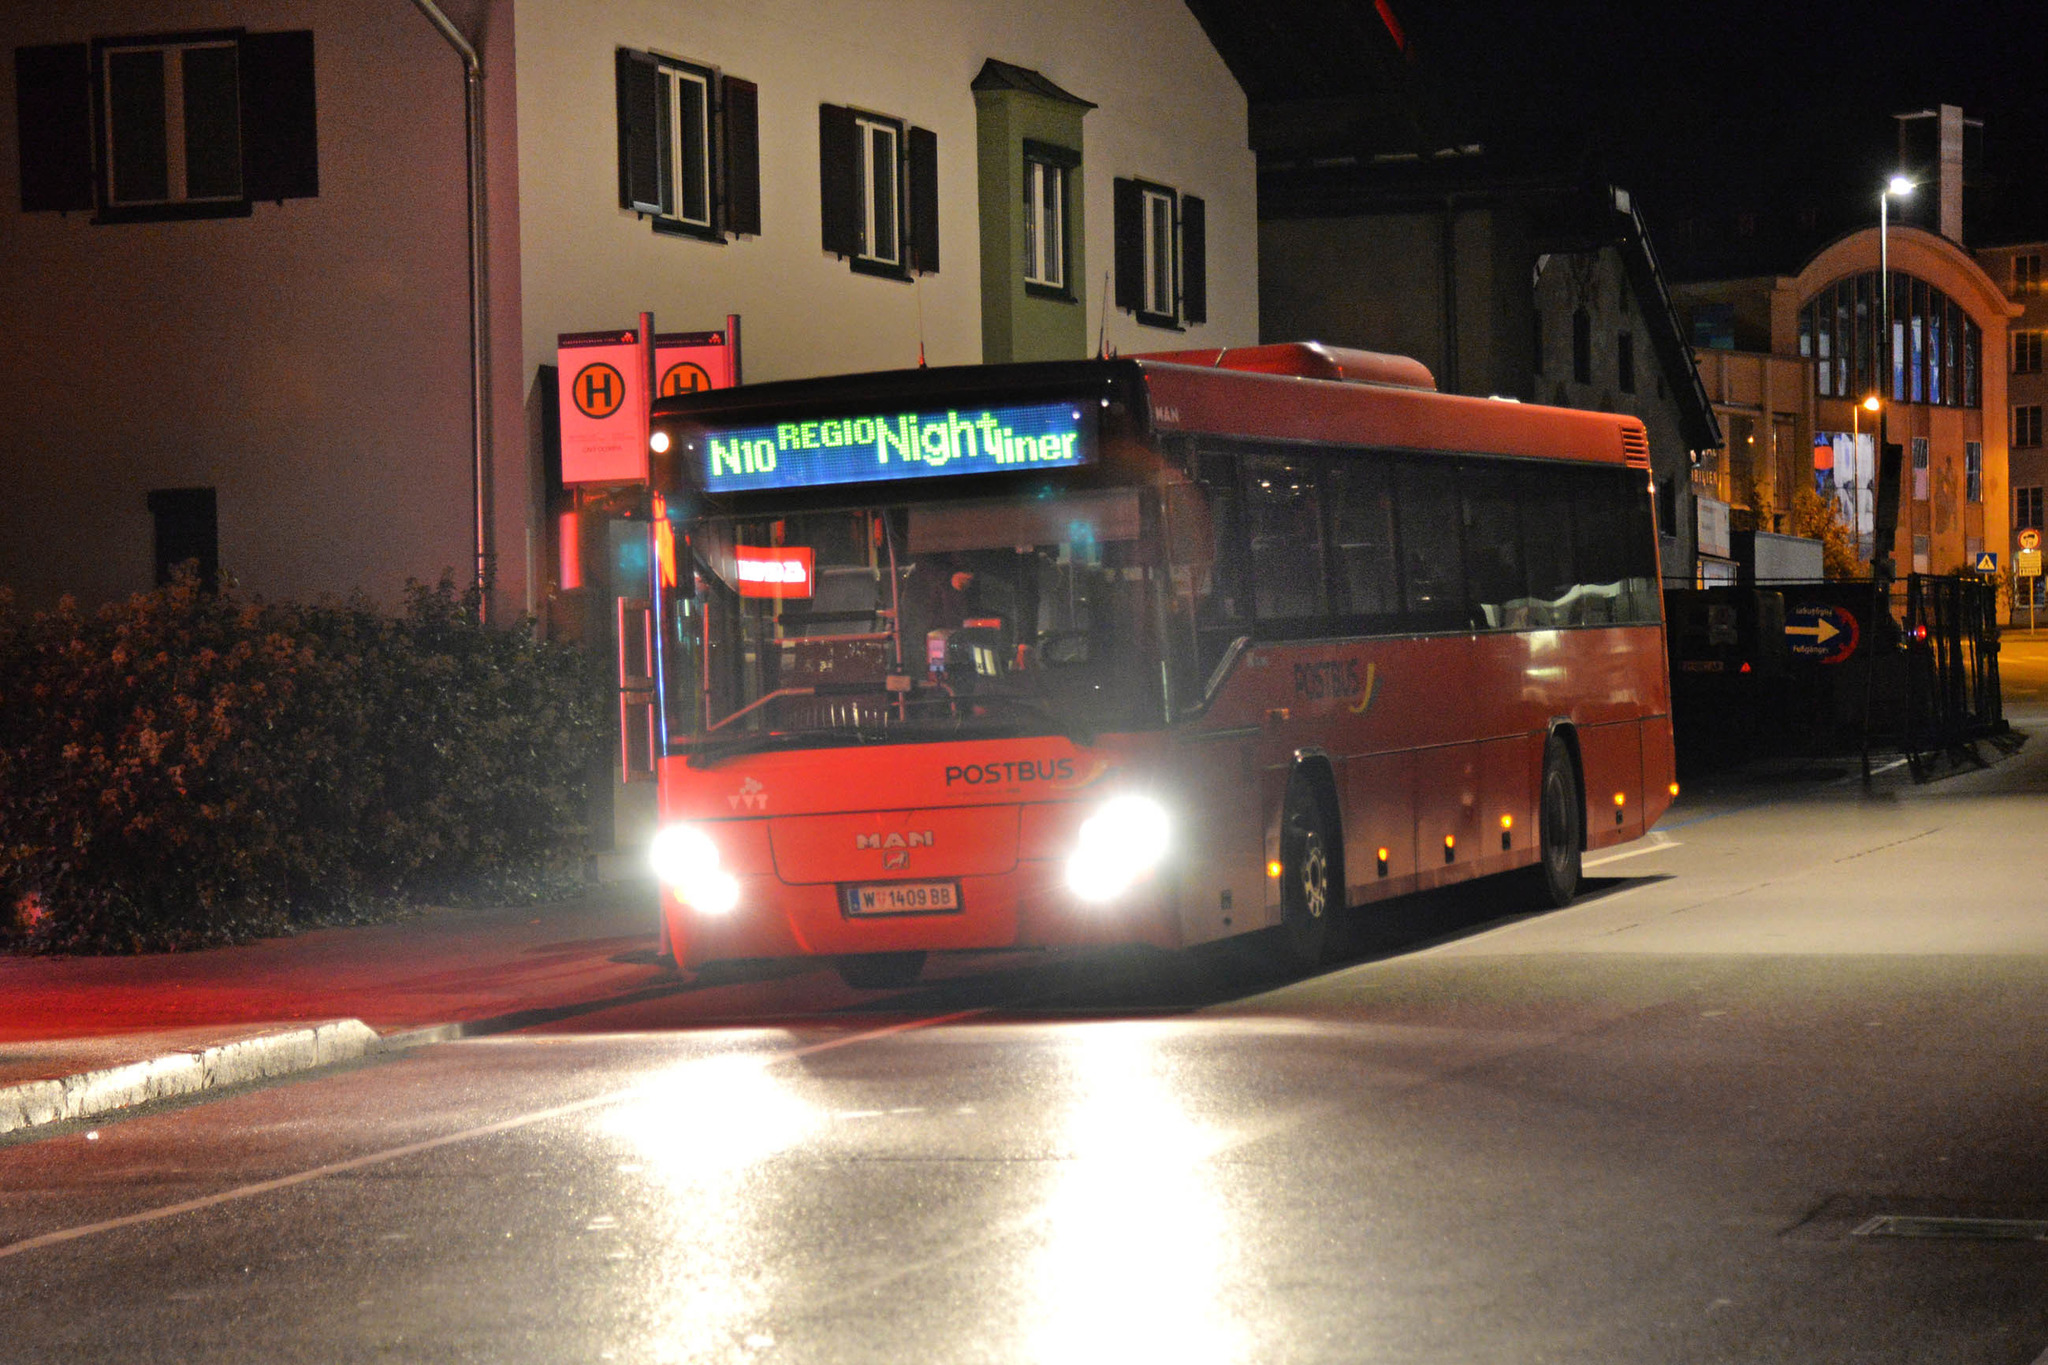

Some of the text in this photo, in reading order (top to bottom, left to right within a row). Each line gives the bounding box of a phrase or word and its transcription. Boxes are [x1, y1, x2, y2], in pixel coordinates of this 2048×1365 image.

[585, 373, 612, 409] H
[710, 437, 776, 476] N10
[777, 418, 875, 450] REGIO
[945, 758, 1075, 787] POSTBUS
[728, 794, 768, 810] VVT
[856, 831, 933, 850] MAN
[863, 891, 875, 909] W
[890, 888, 928, 907] 1409
